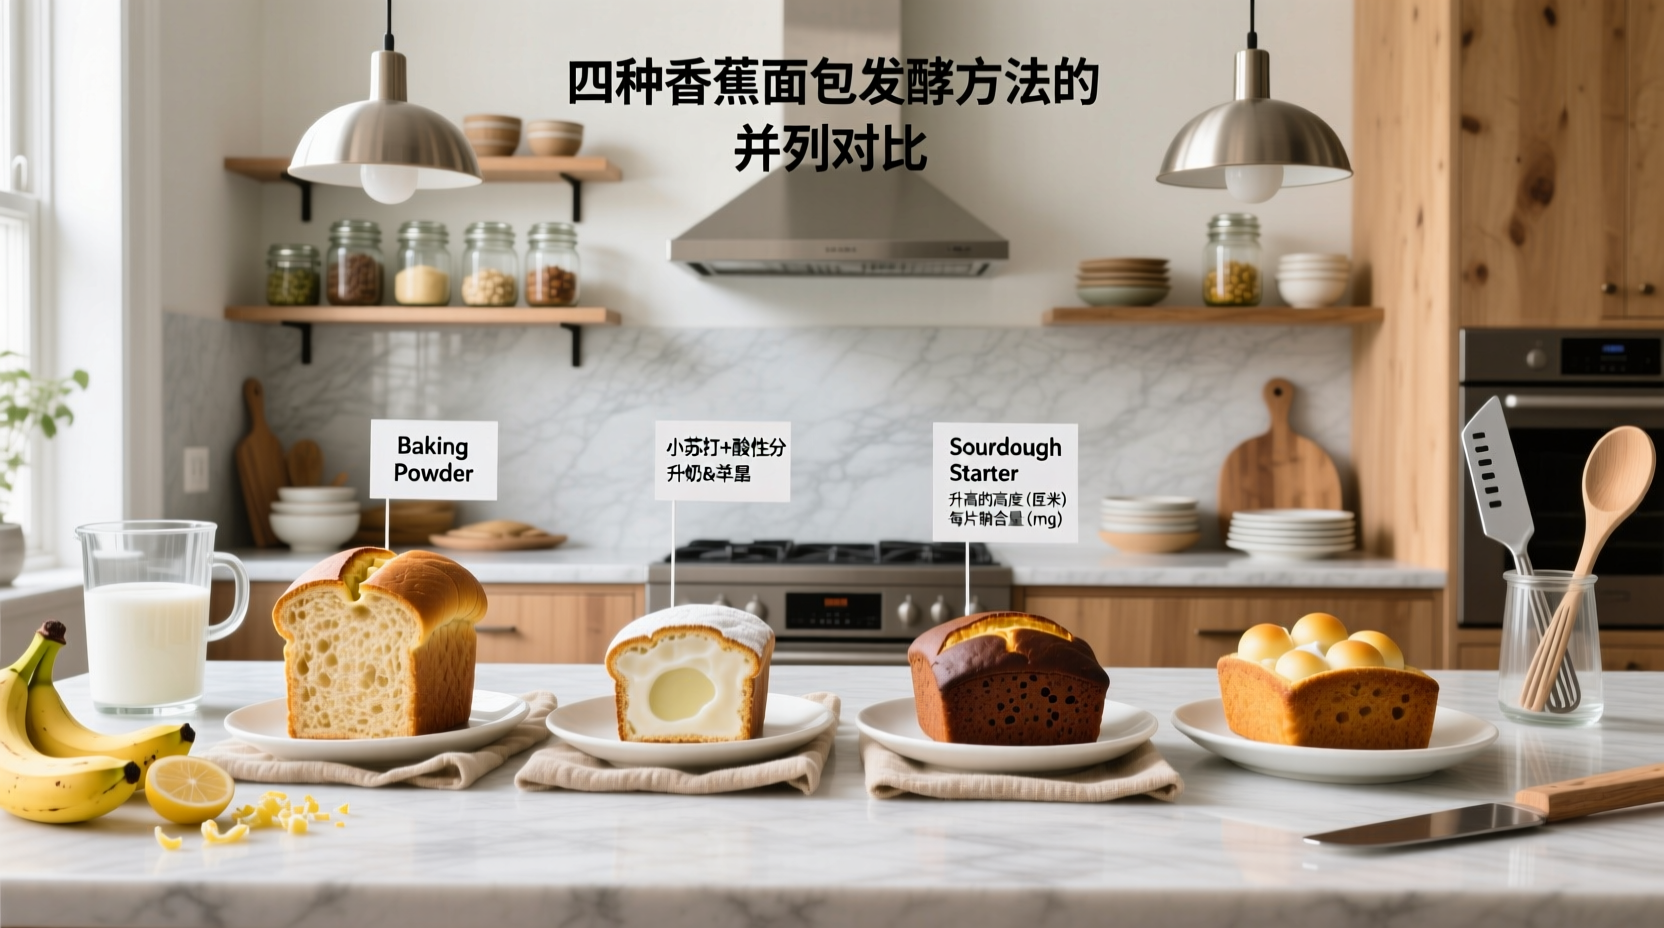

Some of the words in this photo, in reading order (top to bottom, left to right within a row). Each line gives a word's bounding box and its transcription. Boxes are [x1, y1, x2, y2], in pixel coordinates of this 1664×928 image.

[398, 435, 468, 461] Baking
[949, 436, 1062, 462] Sourdough
[394, 462, 474, 483] Powder
[949, 463, 1019, 482] Starter
